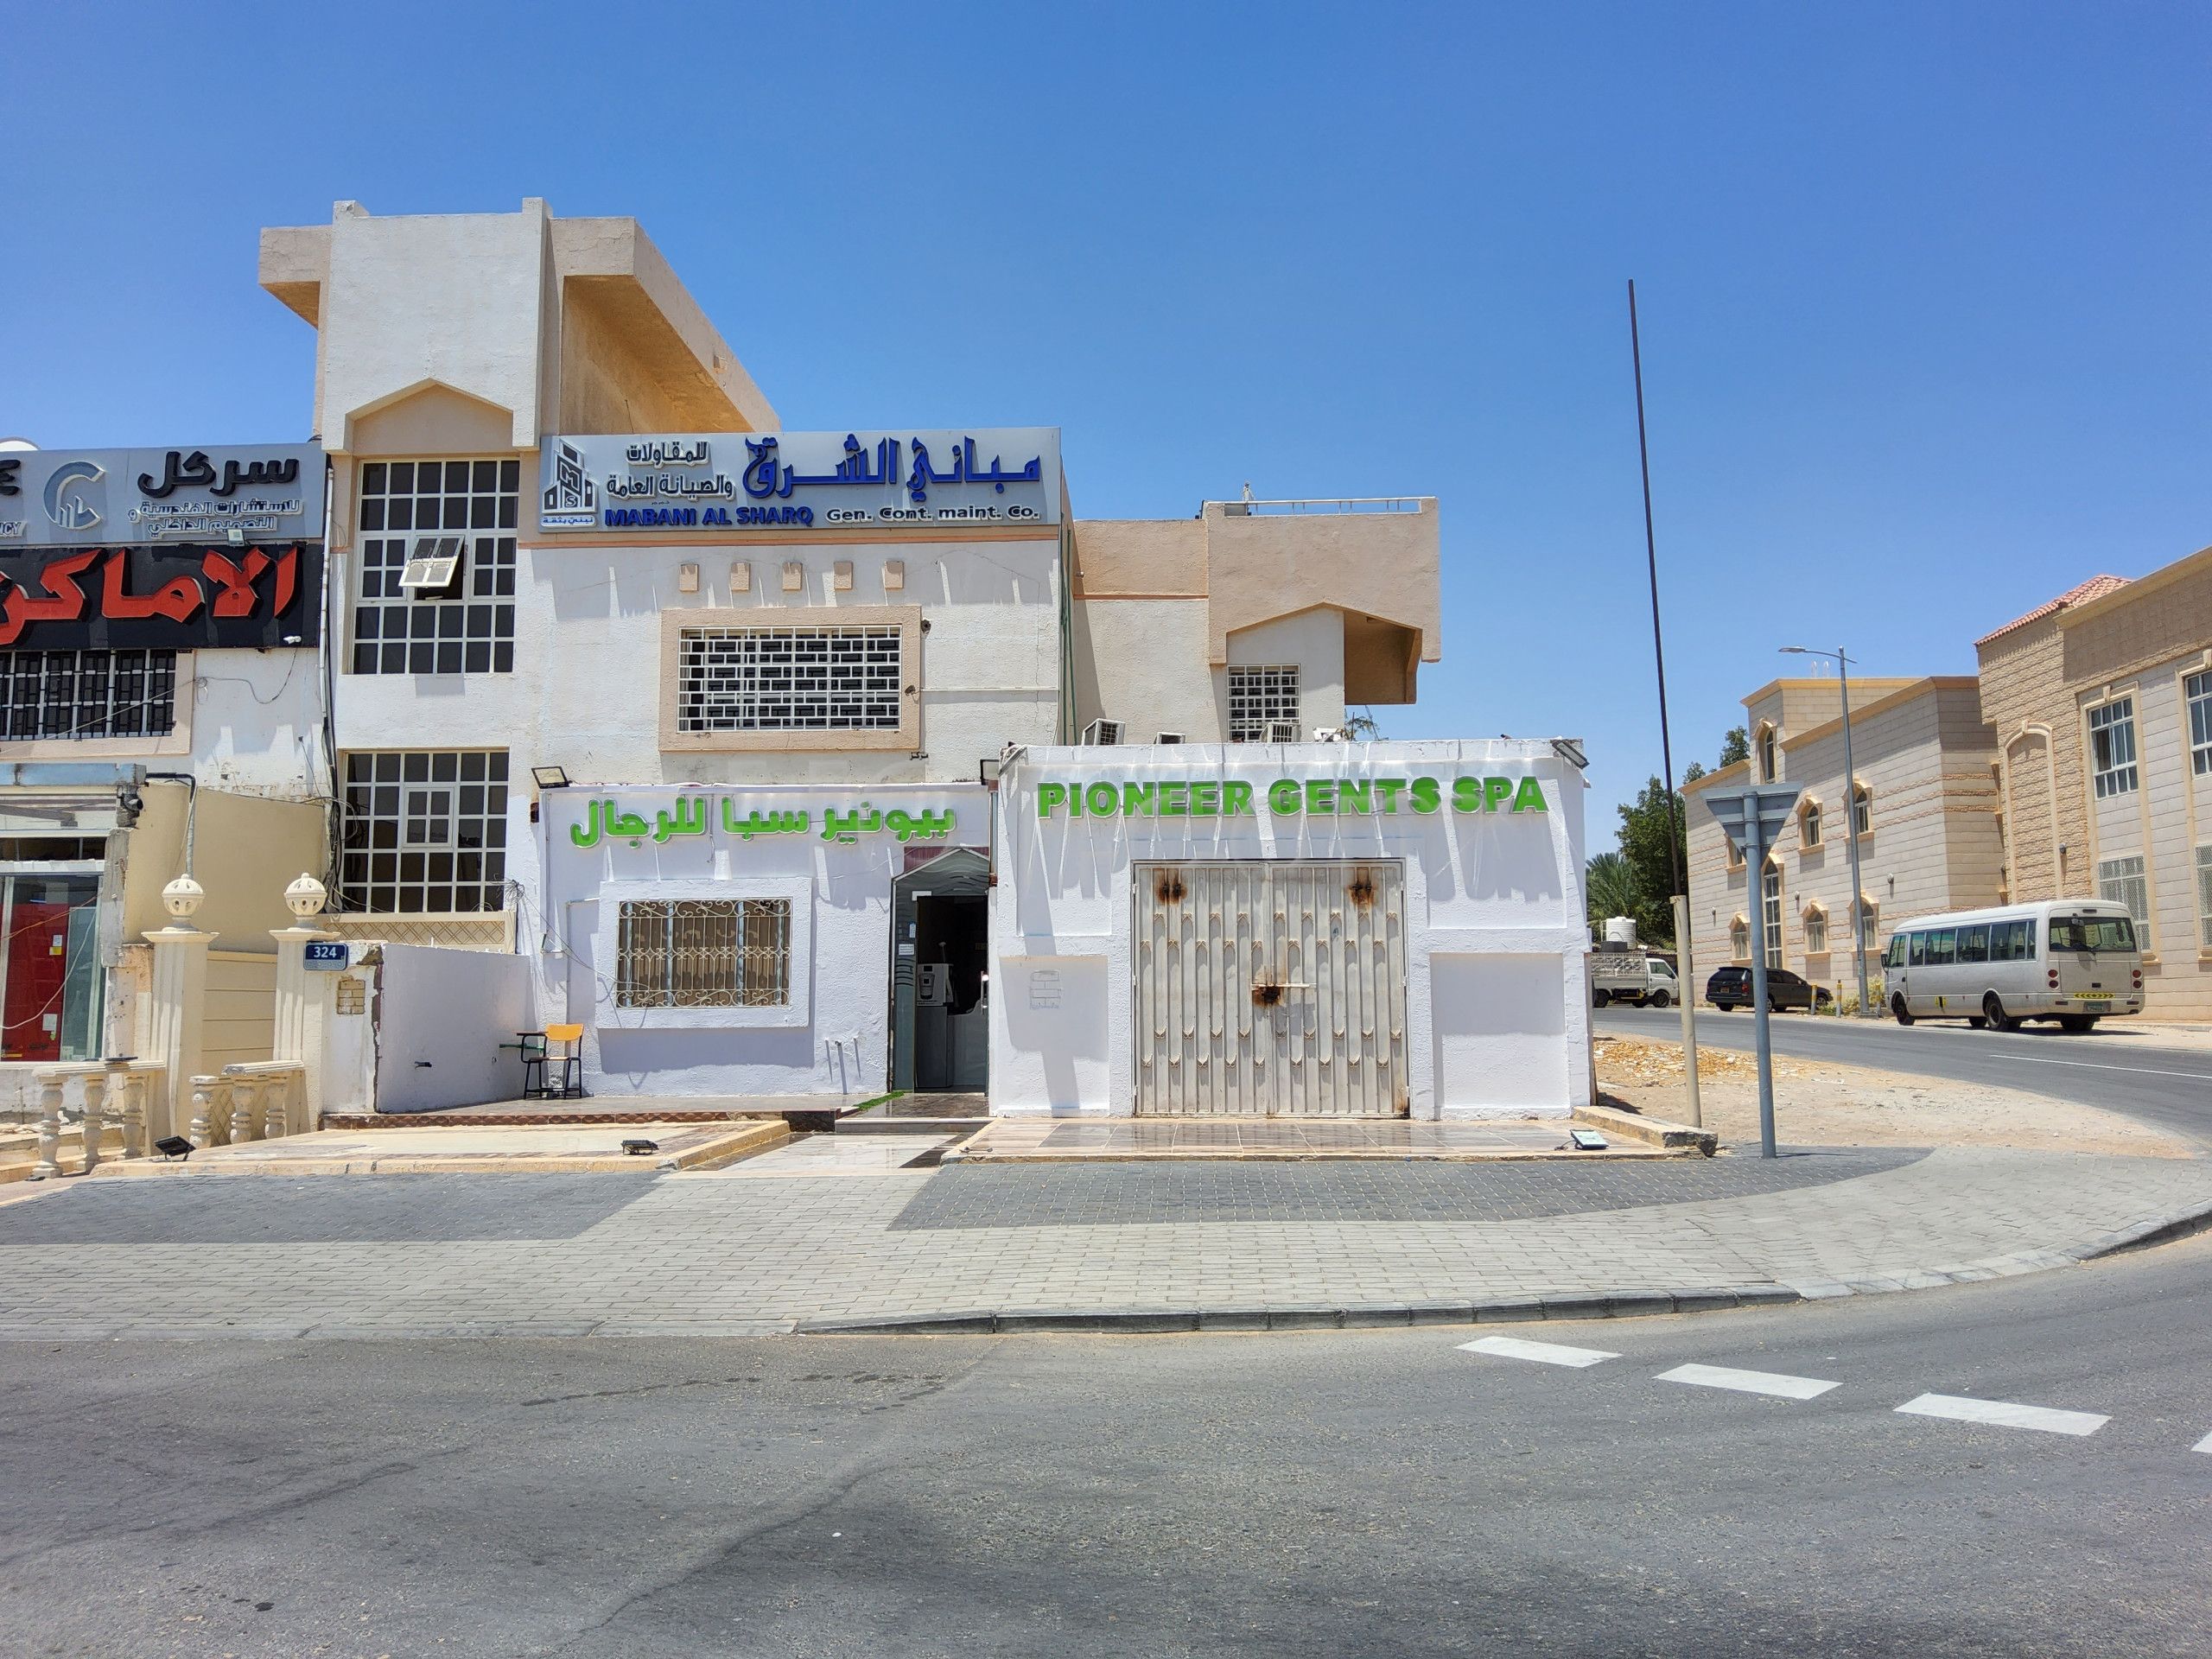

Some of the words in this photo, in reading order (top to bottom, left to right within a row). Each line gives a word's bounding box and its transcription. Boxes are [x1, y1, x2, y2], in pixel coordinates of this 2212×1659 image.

[626, 441, 708, 466] للمقاولات
[742, 433, 899, 499] الشرق
[137, 450, 300, 499] سركل
[906, 435, 1040, 502] مباني
[607, 474, 654, 497] العامة
[658, 474, 734, 499] والصيانة
[141, 501, 213, 518] الهندسية
[214, 498, 301, 517] للاستشارات
[605, 508, 697, 527] MABANI
[702, 508, 733, 525] AL
[736, 506, 814, 527] SHARQ
[827, 508, 873, 522] Gen.
[880, 508, 931, 521] Cont.
[938, 505, 1002, 519] maint.
[1007, 505, 1039, 518] Co.
[149, 518, 207, 538] الداخلي
[208, 516, 274, 533] التصميم
[1037, 780, 1255, 819] PIONEER
[1268, 776, 1442, 817] GENTS
[1451, 775, 1549, 814] SPA
[570, 797, 708, 849] للرجال
[721, 797, 810, 842] سبا
[820, 801, 957, 845] بيونير
[313, 946, 337, 958] 324
